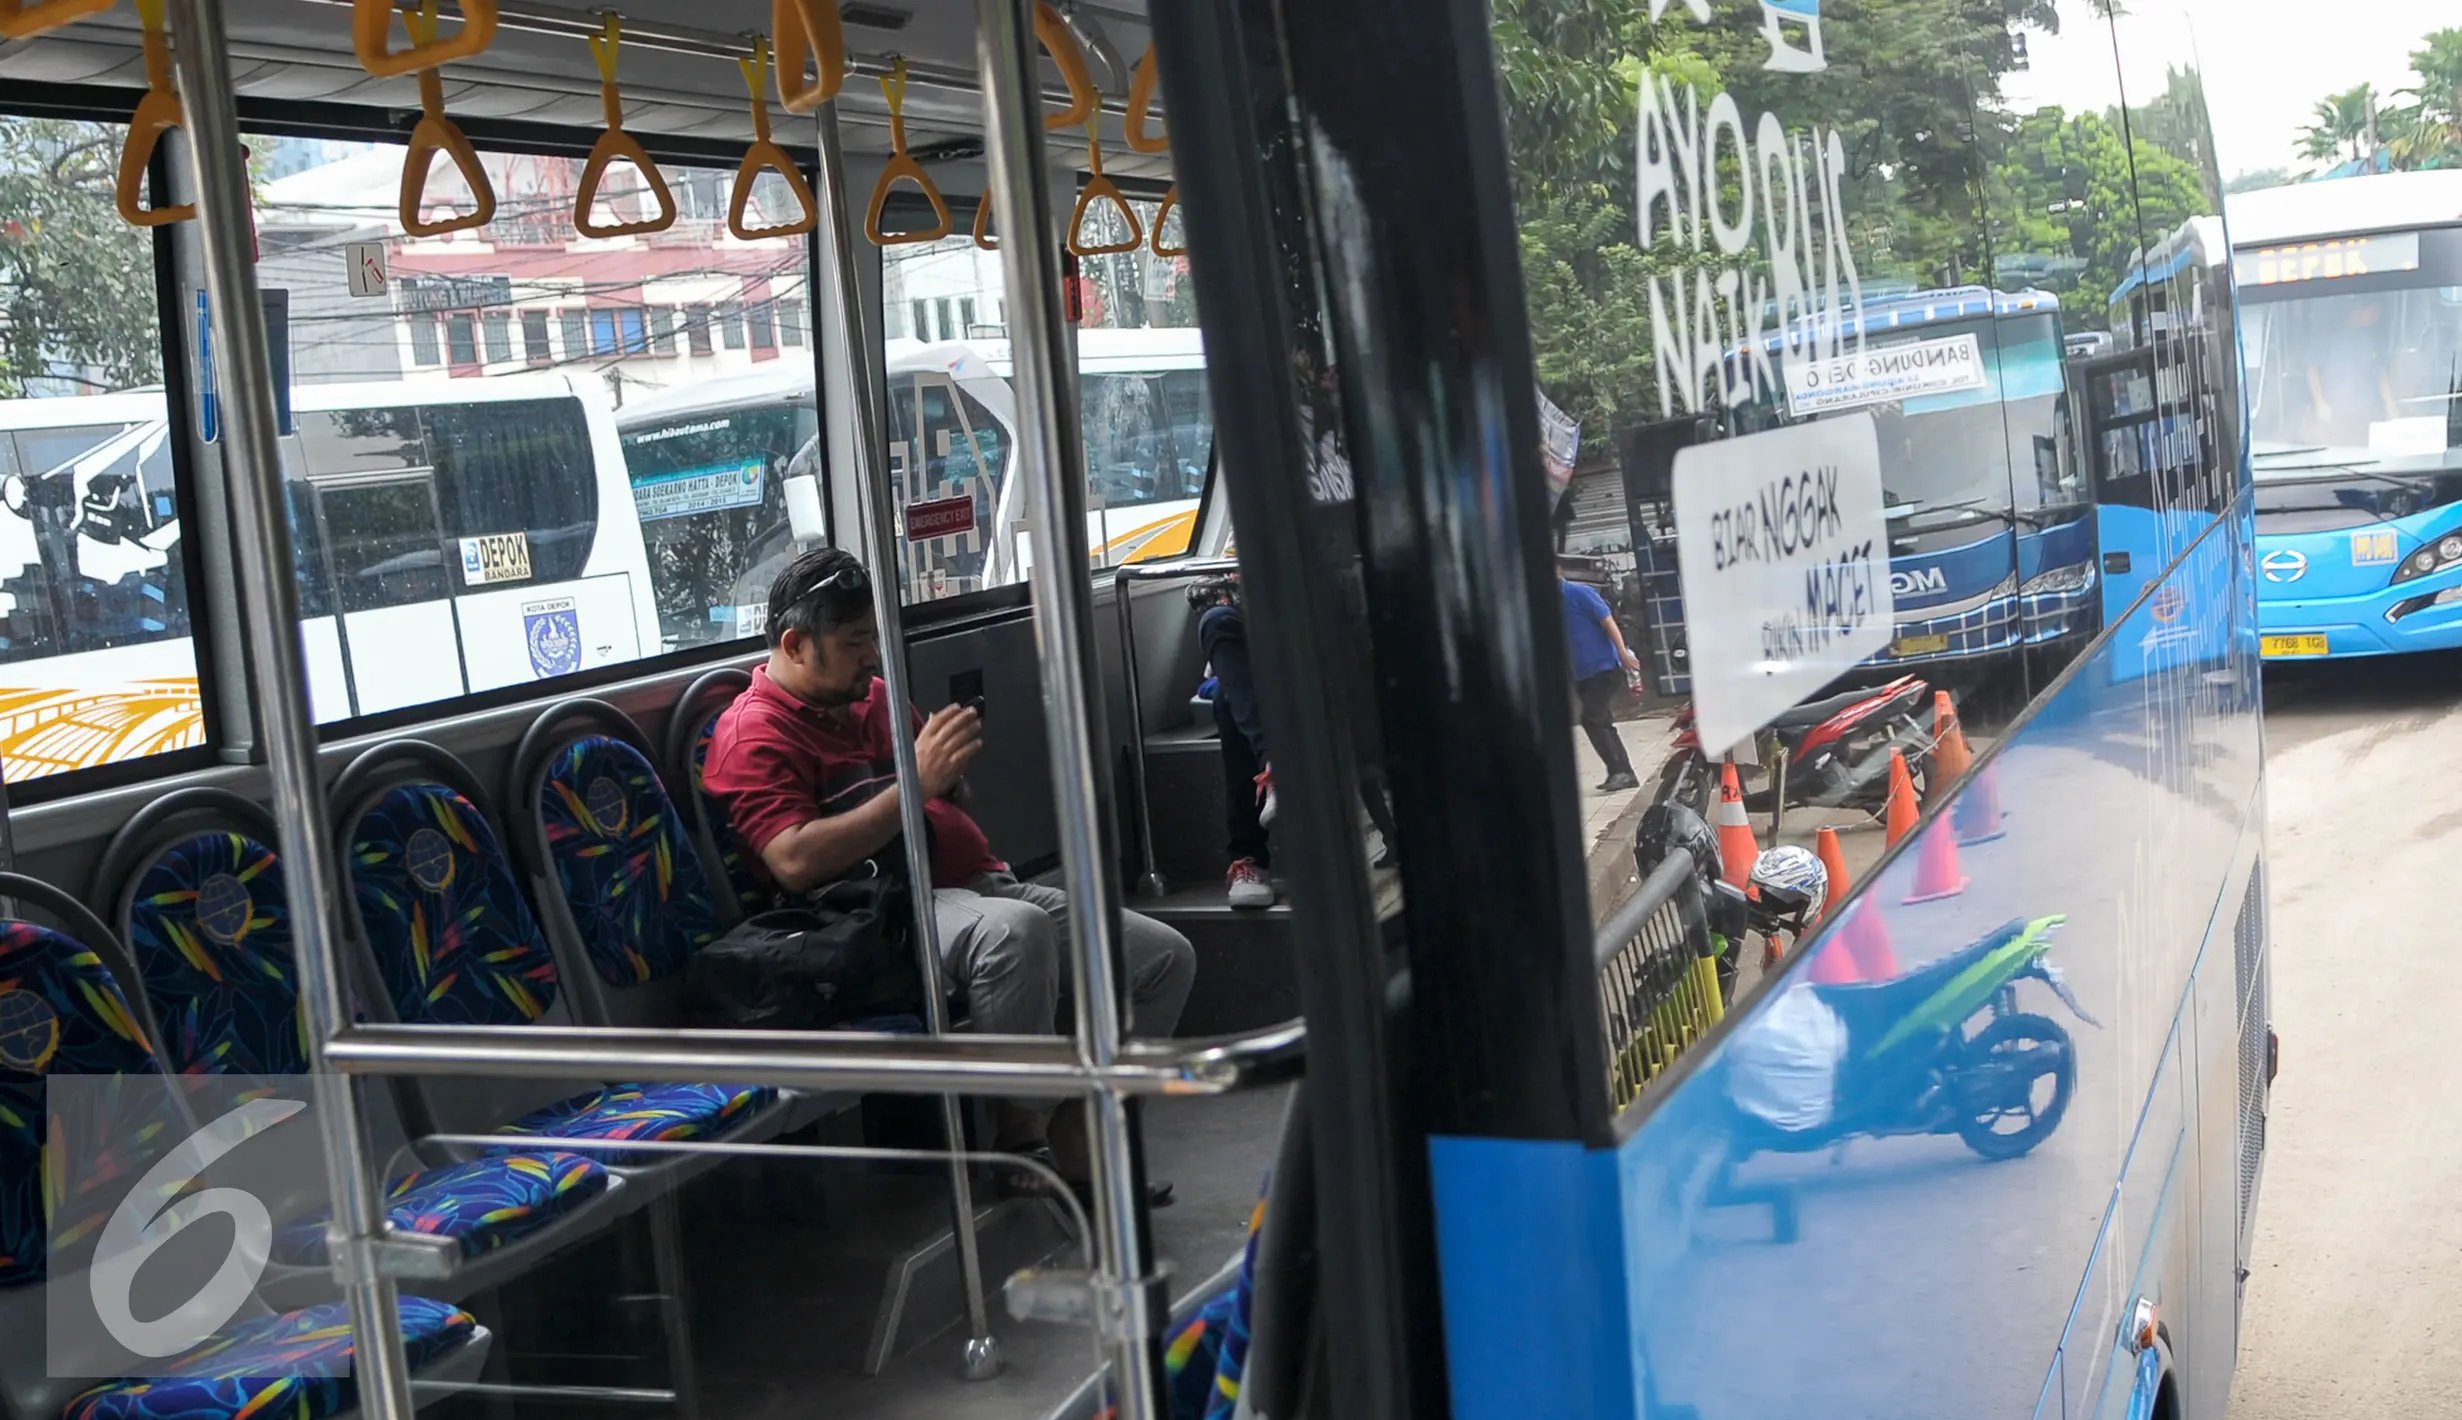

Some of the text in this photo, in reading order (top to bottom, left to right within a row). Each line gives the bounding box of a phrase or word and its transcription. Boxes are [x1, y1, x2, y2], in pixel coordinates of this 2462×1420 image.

[1636, 66, 1753, 255] AYO
[1649, 111, 1866, 418] NAIK BUS
[479, 535, 528, 569] DEPOK
[909, 507, 970, 531] EMERGENCY EXIT
[1711, 465, 1842, 571] BIAR NGGAK
[485, 567, 530, 581] BANDARA
[526, 601, 570, 613] KOTA DEPOK
[1806, 539, 1875, 653] MACET
